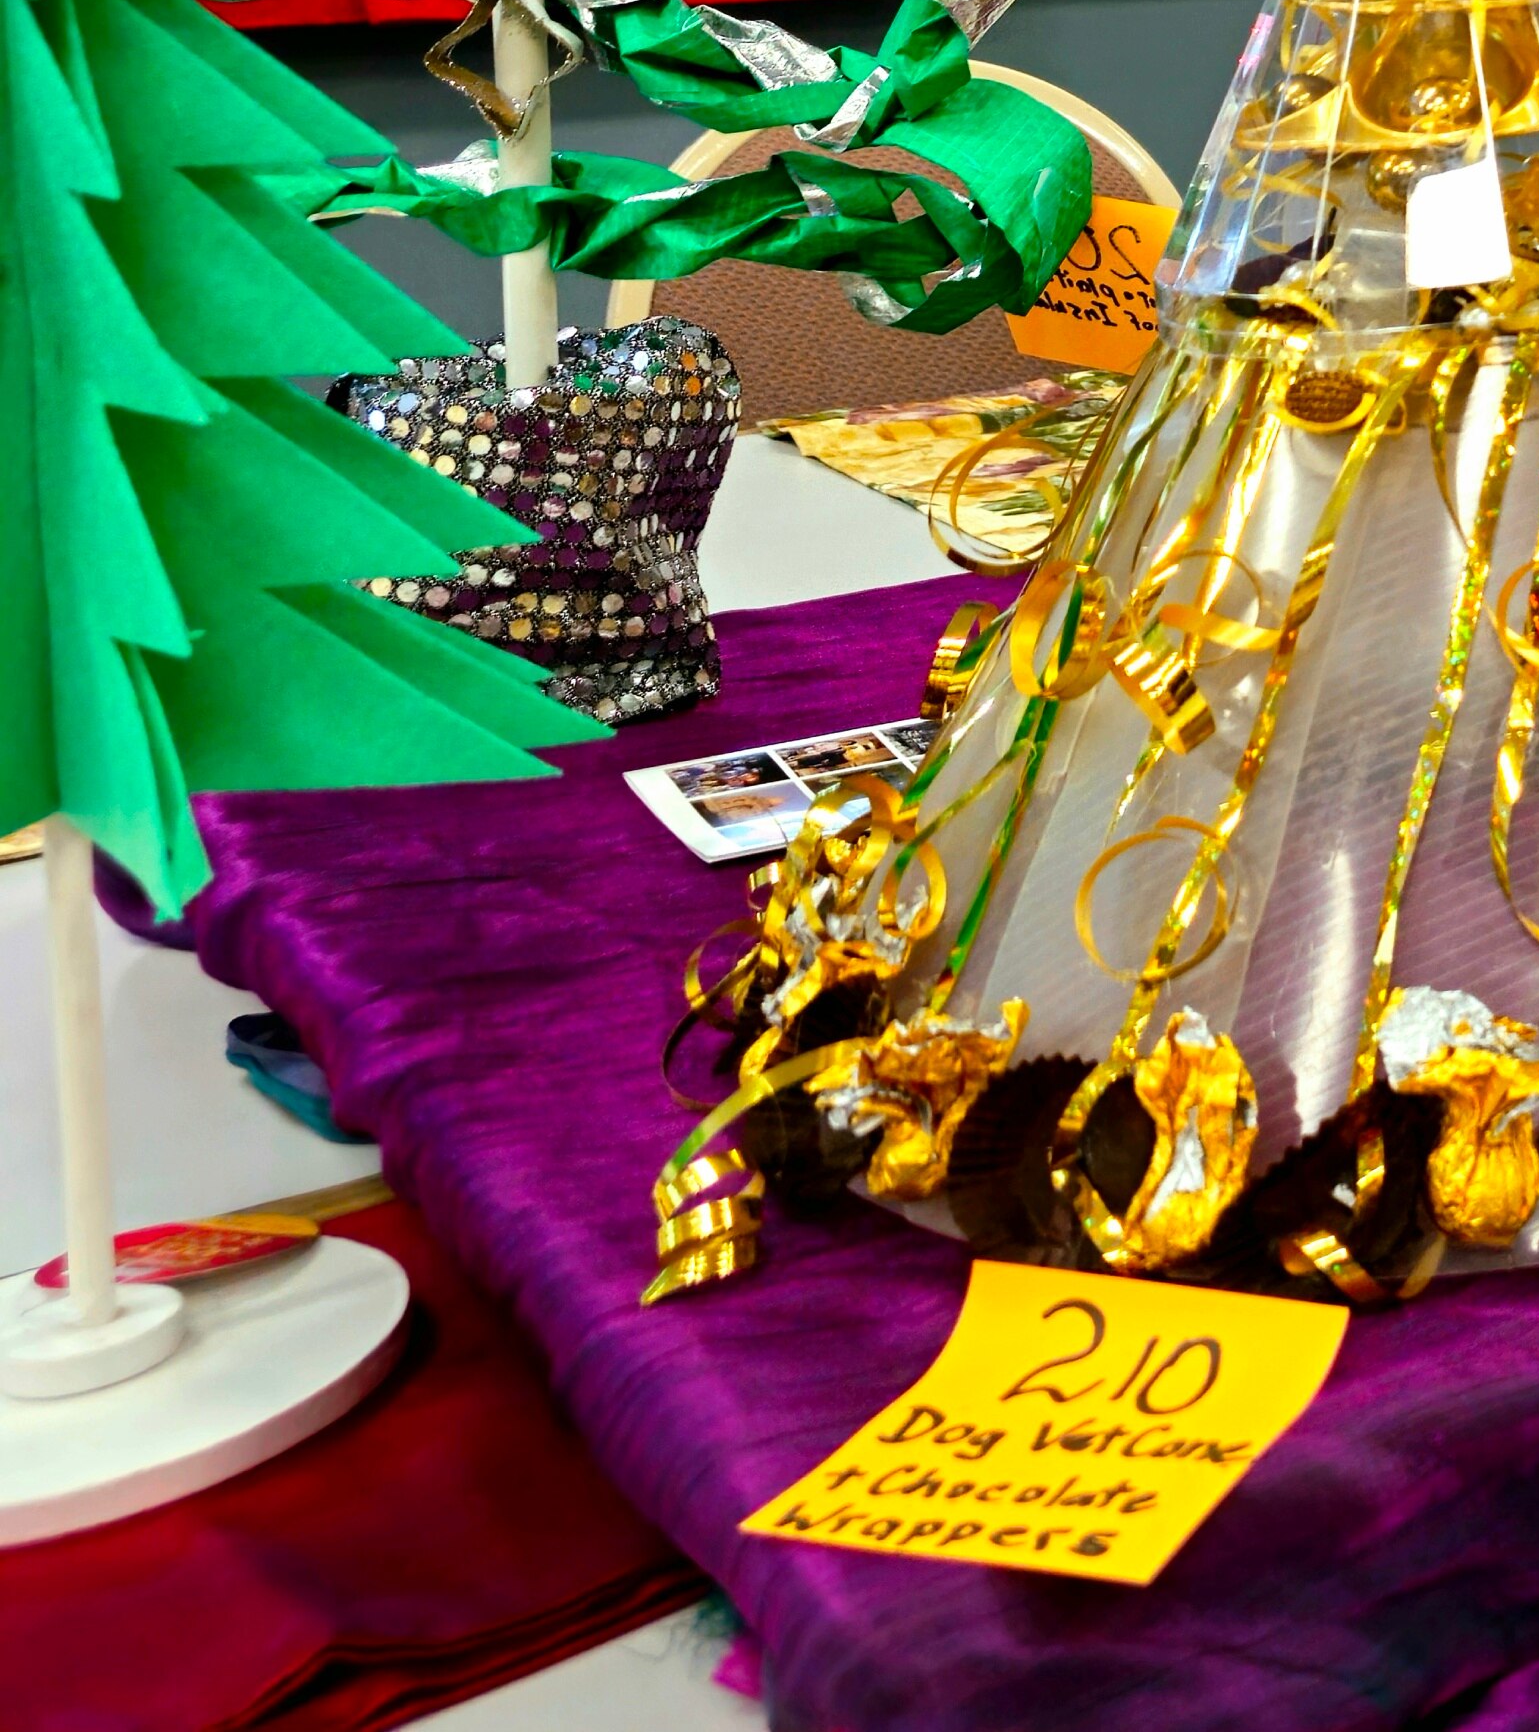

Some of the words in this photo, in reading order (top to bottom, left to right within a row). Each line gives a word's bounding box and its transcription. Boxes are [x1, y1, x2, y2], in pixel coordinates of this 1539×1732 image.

[1000, 1298, 1222, 1415] 210
[879, 1406, 1005, 1460] Dog
[868, 1464, 1157, 1516] Chocolate
[775, 1502, 1120, 1557] Wrappers
